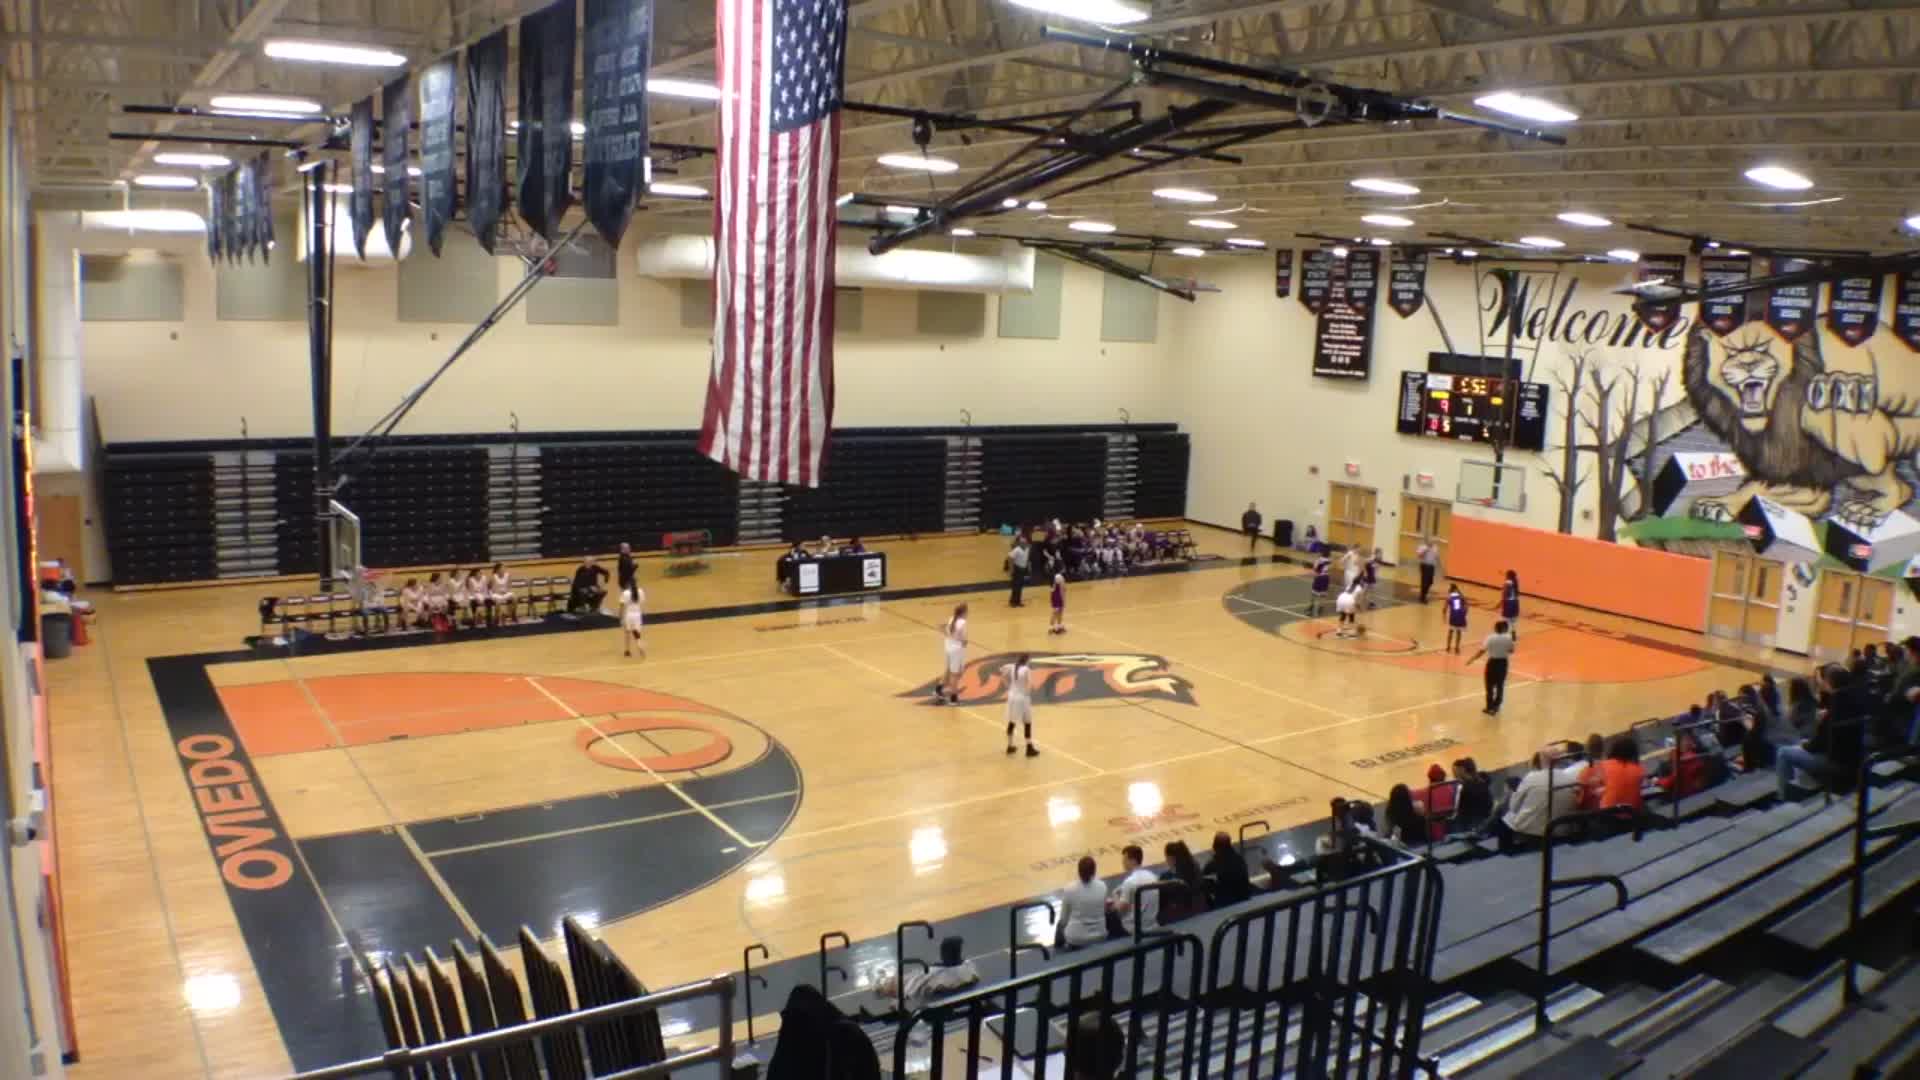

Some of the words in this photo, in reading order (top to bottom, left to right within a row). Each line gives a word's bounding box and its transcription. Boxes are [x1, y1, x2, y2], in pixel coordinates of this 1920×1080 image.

[1478, 267, 1690, 350] Welcome
[1688, 461, 1706, 480] to
[1709, 455, 1738, 478] the
[177, 733, 294, 891] OVIEDO
